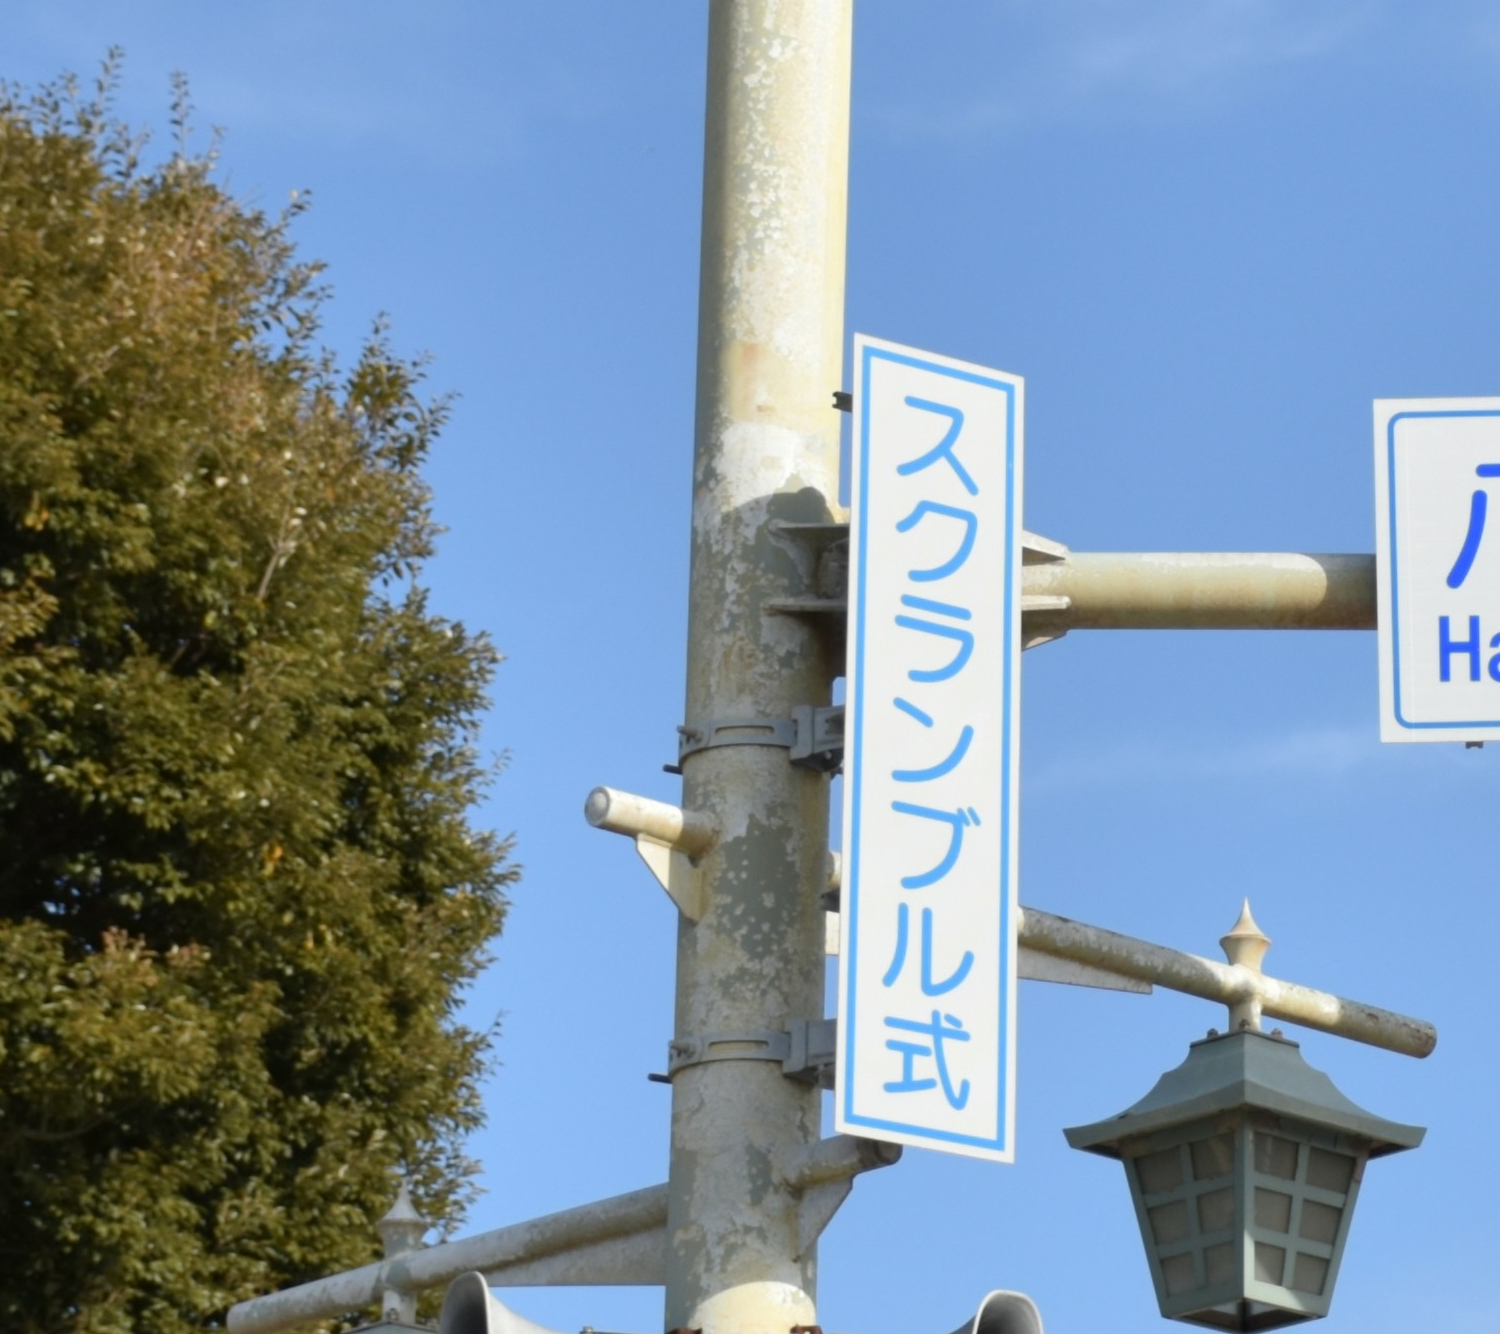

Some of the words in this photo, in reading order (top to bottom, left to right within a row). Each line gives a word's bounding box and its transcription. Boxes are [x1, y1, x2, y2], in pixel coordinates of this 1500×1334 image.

[884, 396, 981, 1111] スクランブル式
